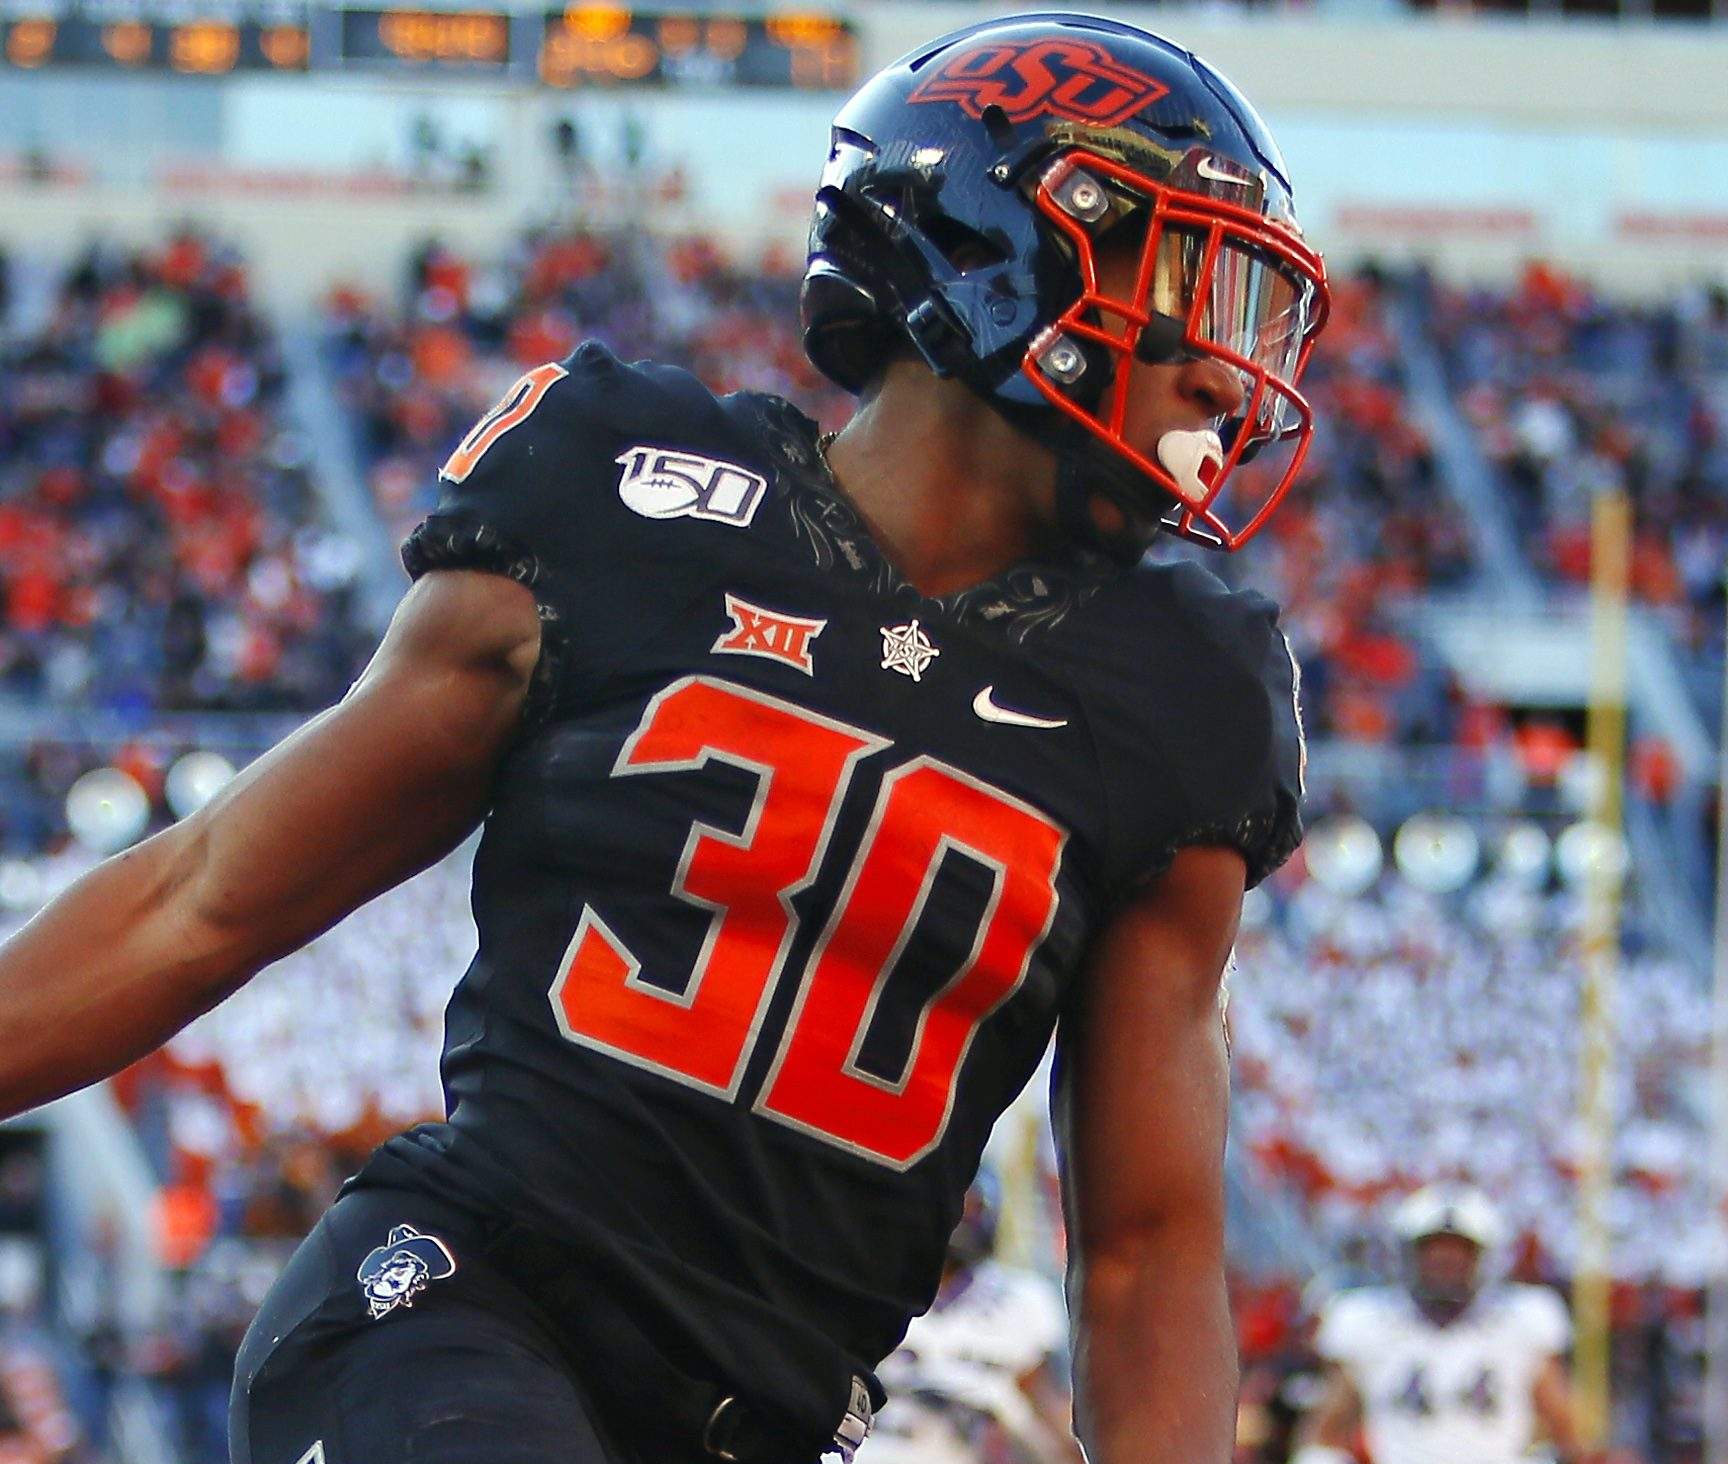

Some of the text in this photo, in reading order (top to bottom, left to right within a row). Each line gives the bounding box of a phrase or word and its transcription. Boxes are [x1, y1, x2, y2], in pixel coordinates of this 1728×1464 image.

[906, 38, 1170, 128] OSU
[438, 361, 570, 485] 0
[615, 446, 768, 528] 150
[710, 592, 828, 677] XII
[549, 676, 1069, 1173] 30
